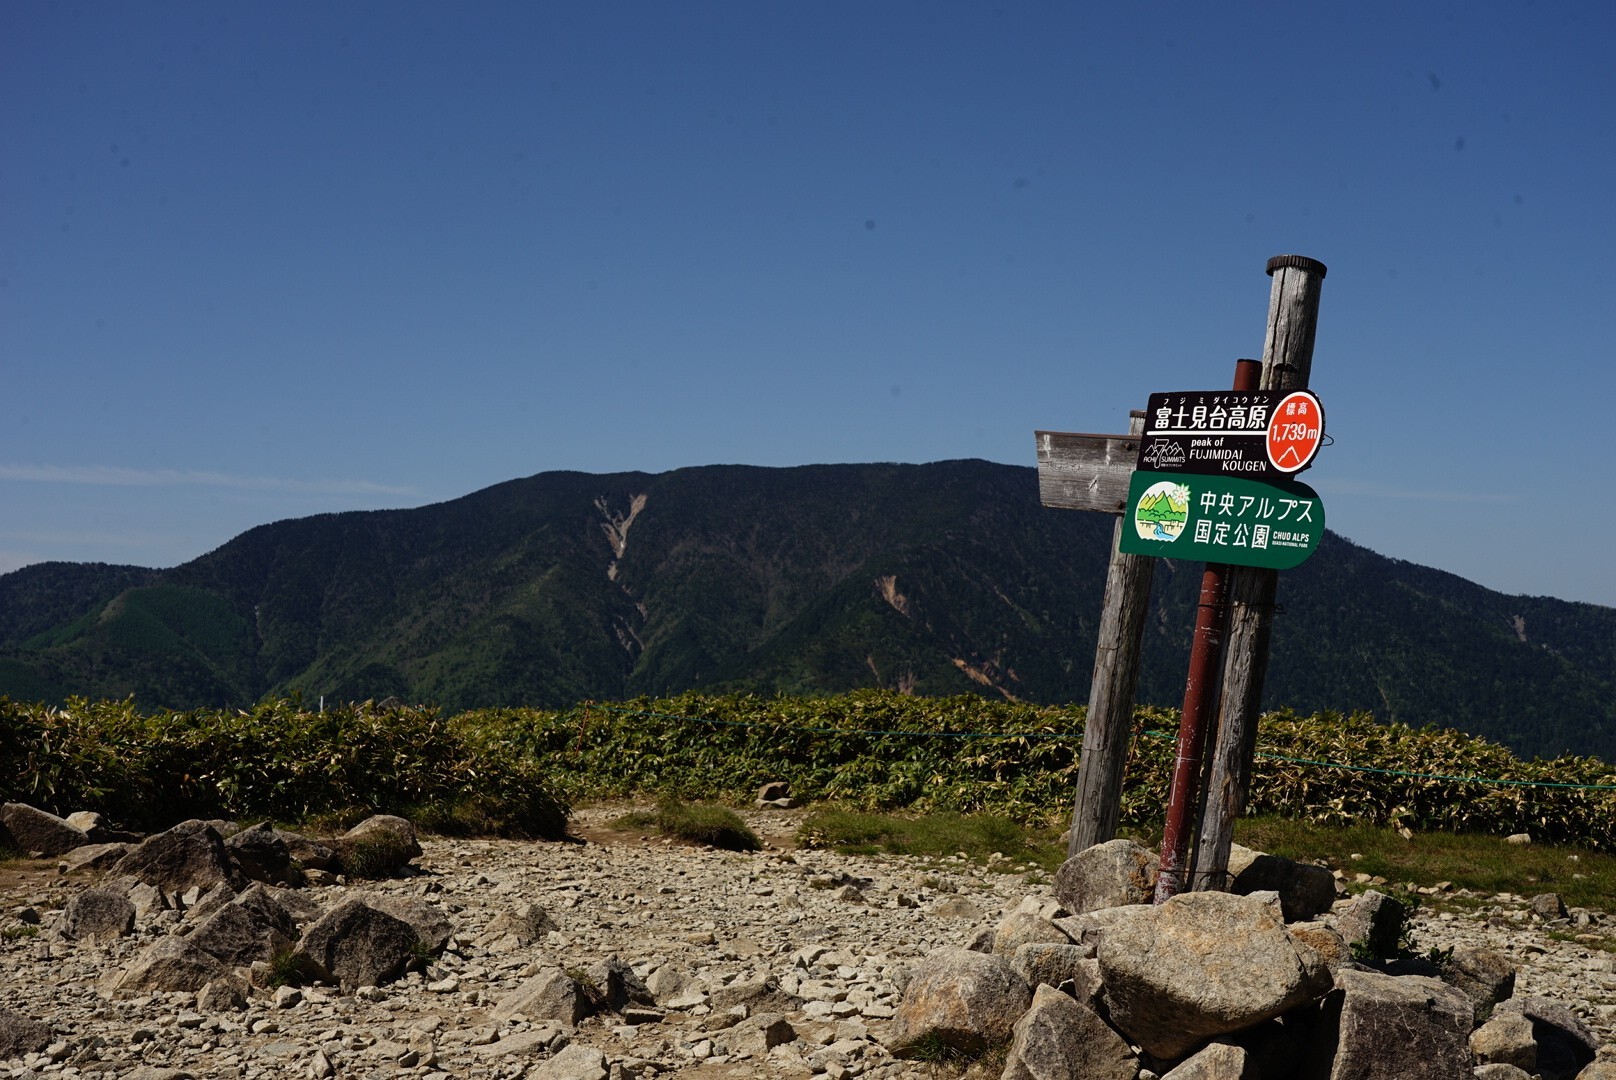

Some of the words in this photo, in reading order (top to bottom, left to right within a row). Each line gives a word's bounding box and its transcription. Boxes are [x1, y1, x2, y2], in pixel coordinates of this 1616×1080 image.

[1286, 402, 1308, 416] 標高
[1155, 405, 1269, 430] 富士見台高原
[1191, 437, 1212, 447] peak
[1214, 437, 1224, 447] of
[1189, 449, 1243, 460] FUJIMIDAI
[1222, 460, 1267, 472] KOUGEN
[1200, 490, 1313, 523] 中央アルプス
[1194, 519, 1270, 550] 国定公園
[1272, 530, 1291, 541] CHUO
[1291, 532, 1310, 543] ALPS
